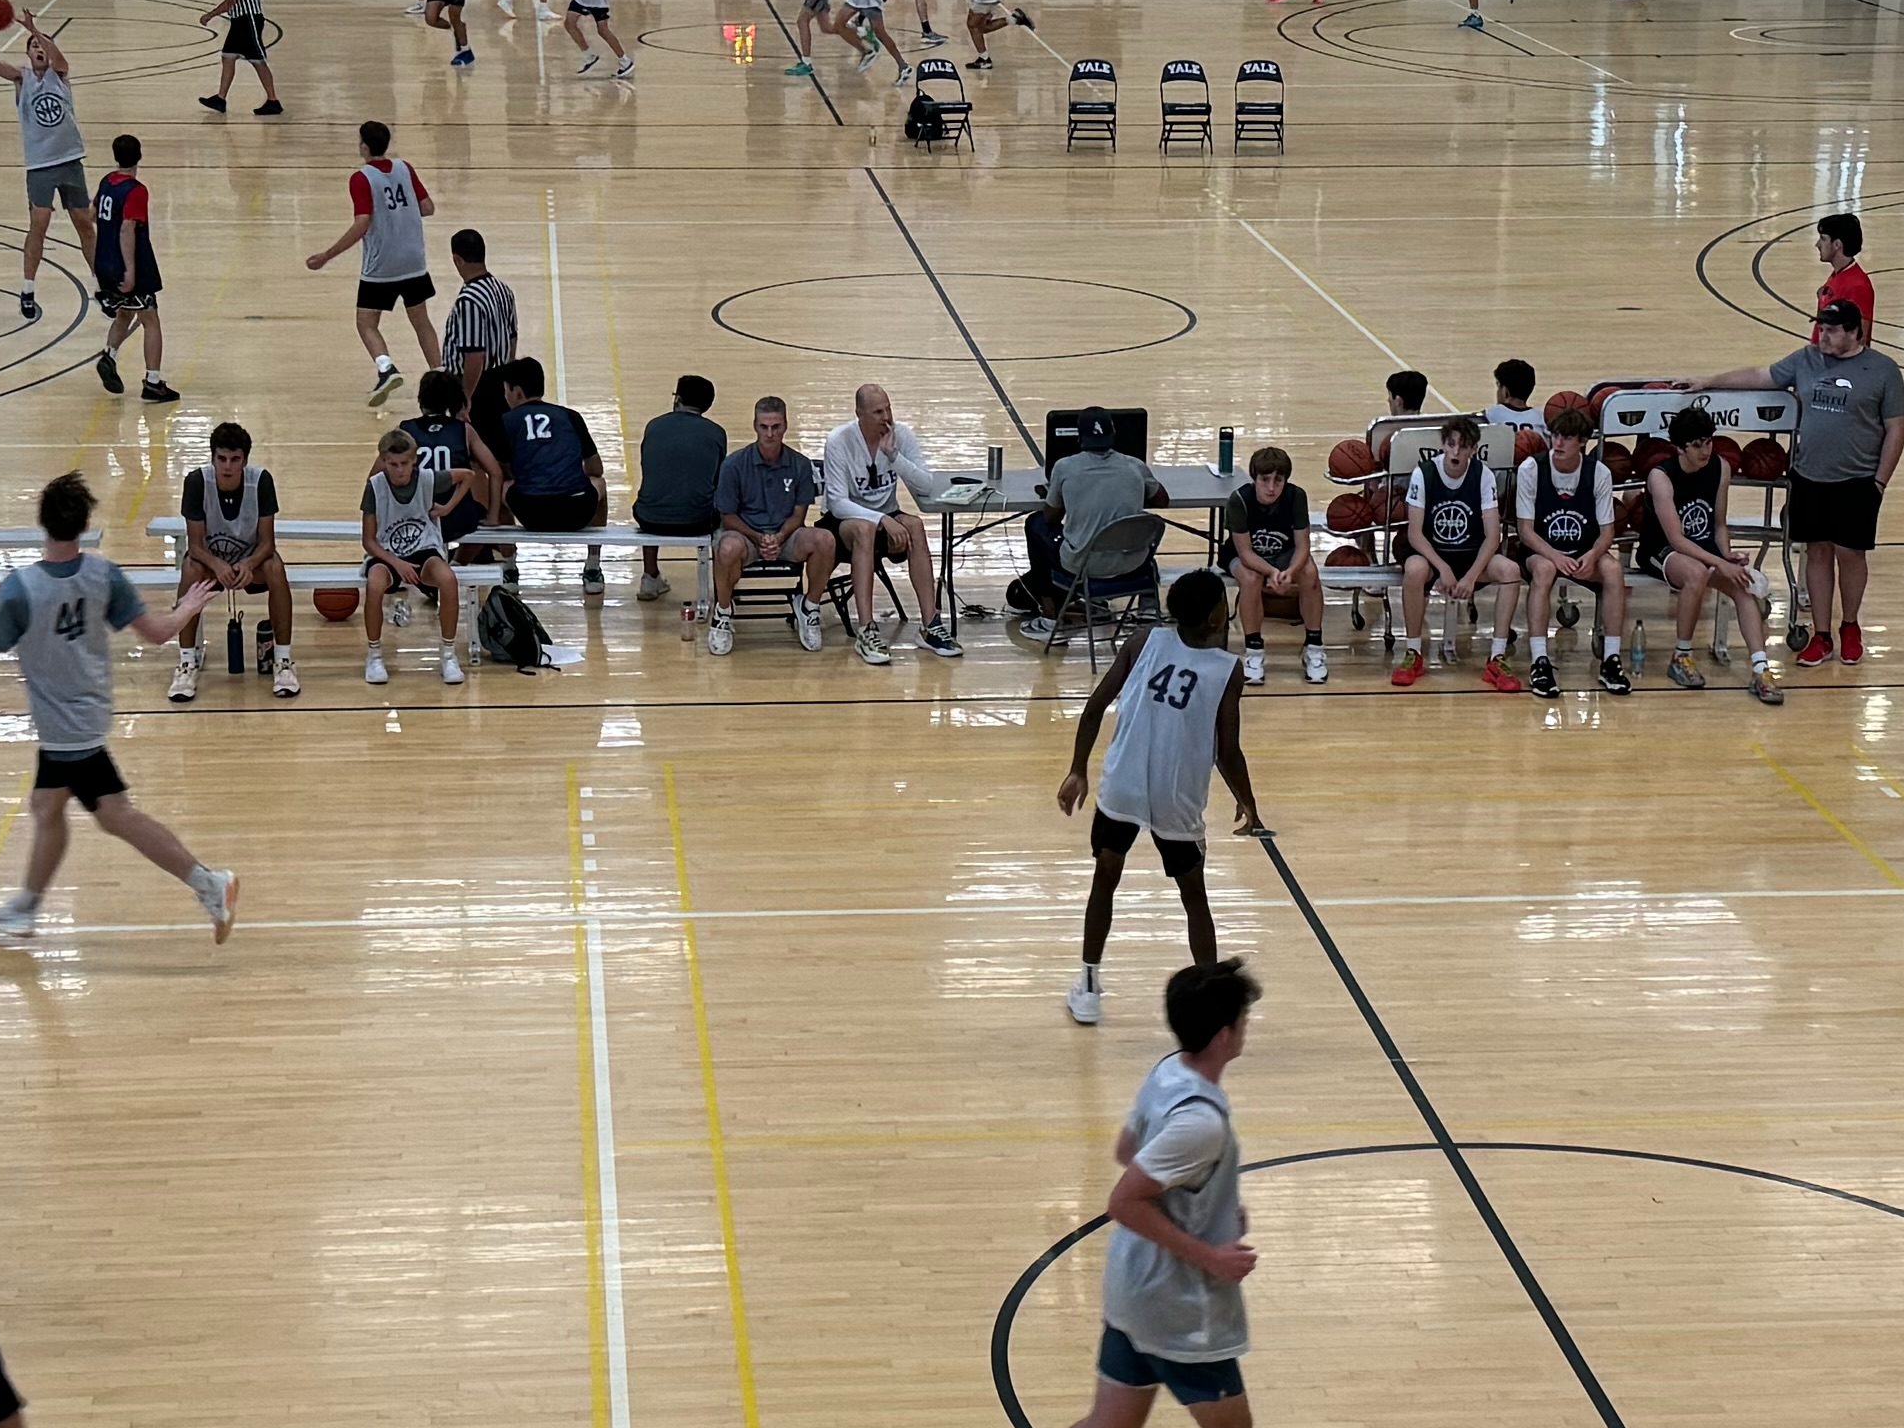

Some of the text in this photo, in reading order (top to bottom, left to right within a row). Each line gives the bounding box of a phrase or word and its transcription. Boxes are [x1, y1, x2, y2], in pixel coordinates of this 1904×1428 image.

[921, 61, 954, 74] YALE
[1077, 61, 1111, 74] YALE
[1167, 62, 1201, 75] YALE
[1243, 62, 1278, 75] YALE
[98, 194, 113, 221] 19
[383, 183, 409, 211] 34
[524, 413, 552, 441] 12
[416, 446, 451, 472] 20
[1147, 664, 1199, 710] 43
